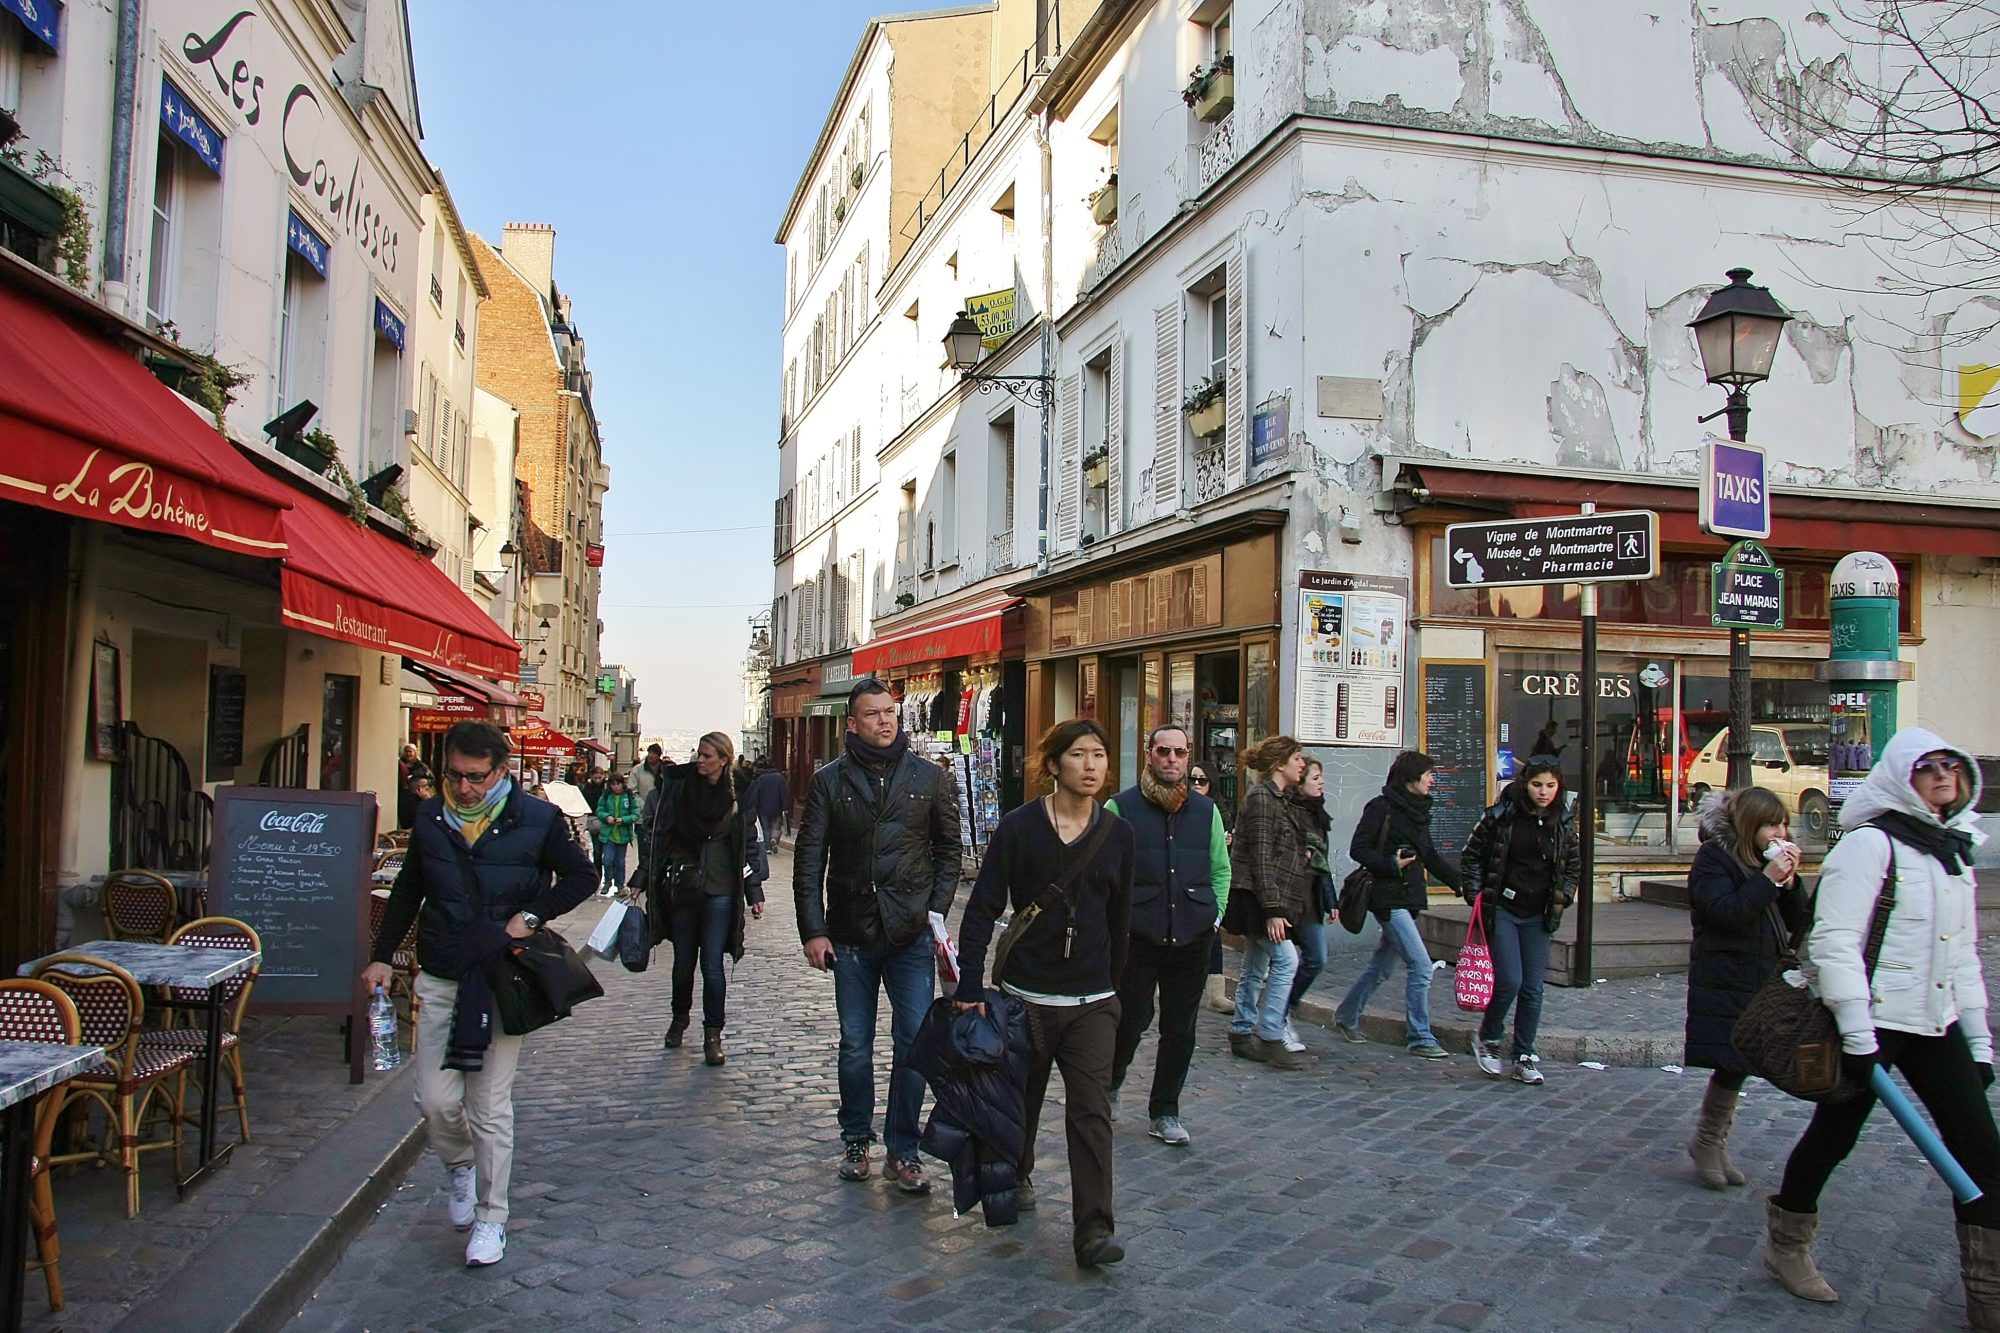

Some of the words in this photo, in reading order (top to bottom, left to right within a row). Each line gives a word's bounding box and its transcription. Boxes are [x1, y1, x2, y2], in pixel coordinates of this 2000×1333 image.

[183, 11, 264, 126] Les
[282, 84, 399, 274] Coulisses
[1264, 416, 1276, 429] RUE
[1266, 429, 1274, 440] DU
[53, 448, 100, 508] La
[109, 462, 208, 532] Bohème
[1716, 472, 1760, 504] TAXIS
[1486, 530, 1517, 543] Vigne
[1524, 528, 1538, 541] de
[1546, 524, 1613, 539] Montmartre
[1486, 546, 1522, 560] Musée
[1528, 544, 1542, 557] de
[1549, 541, 1614, 556] Montmartre
[1541, 559, 1614, 573] Pharmacie
[1311, 576, 1320, 584] Le
[1321, 577, 1342, 585] Jardin
[1343, 578, 1369, 589] d'Agdal
[1734, 573, 1763, 588] PLACE
[1831, 582, 1856, 596] TAXIS
[1872, 581, 1898, 596] TAXIS
[1718, 592, 1742, 606] JEAN
[1744, 594, 1778, 609] MARAIS
[335, 604, 388, 645] Restaurant
[1522, 673, 1632, 699] CRÊES
[260, 810, 328, 834] Coca-Cola
[238, 835, 285, 852] Menu
